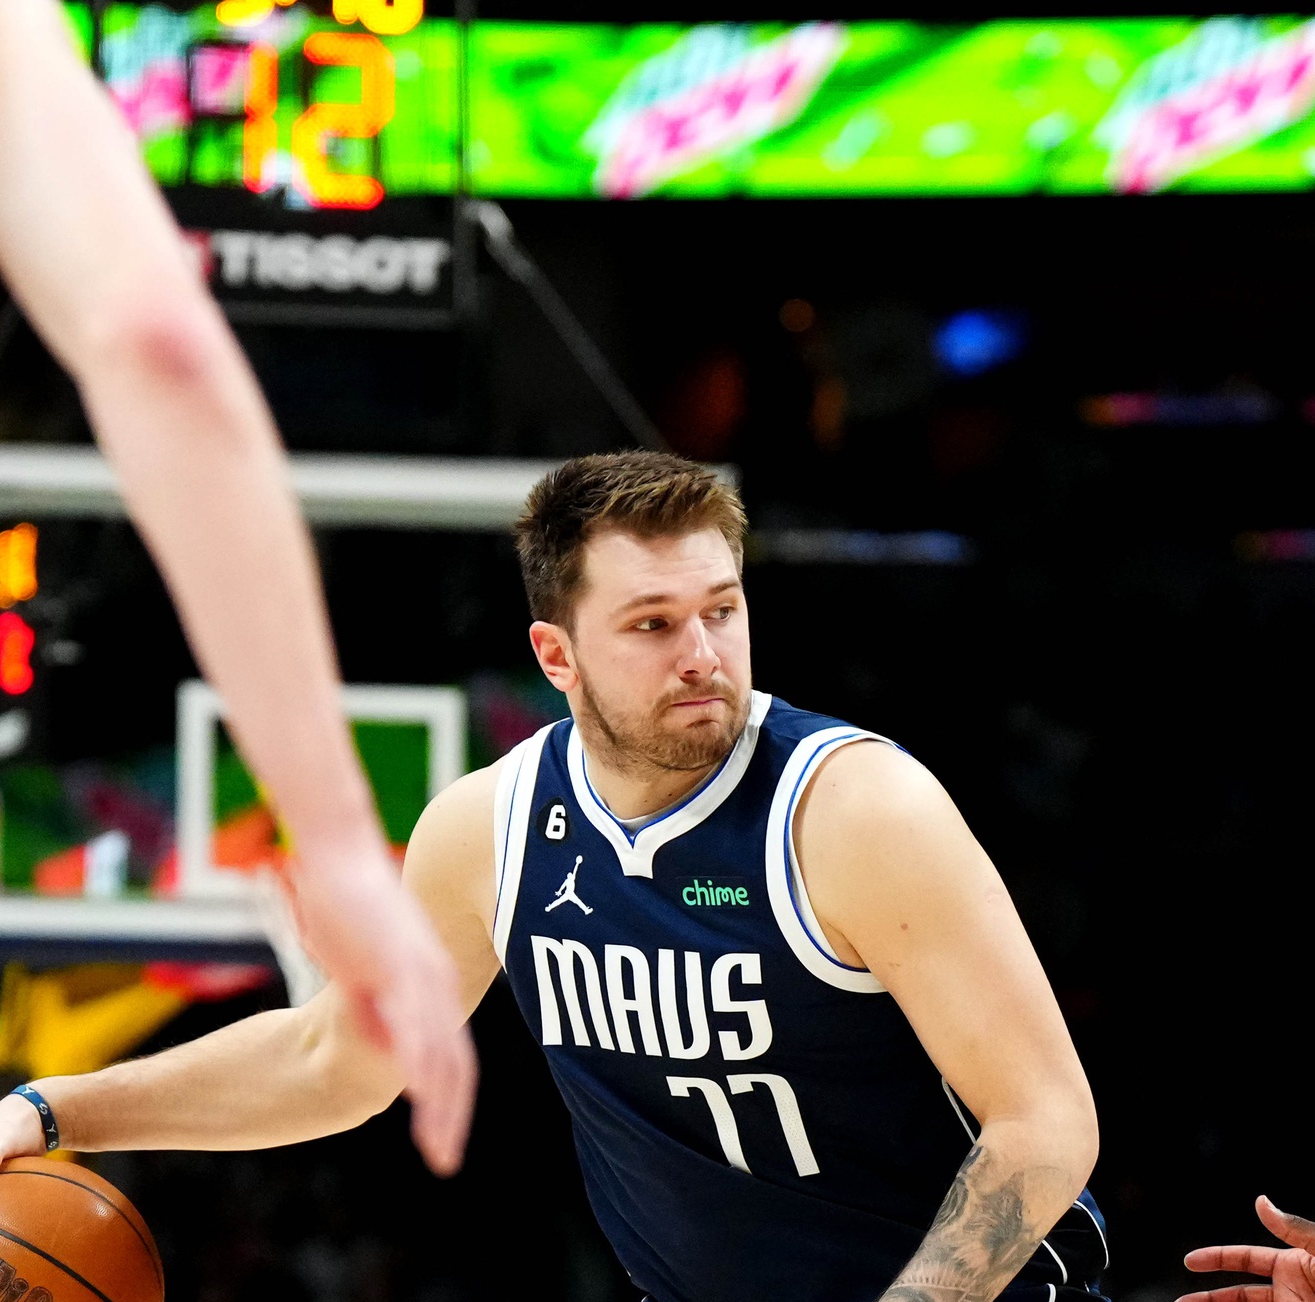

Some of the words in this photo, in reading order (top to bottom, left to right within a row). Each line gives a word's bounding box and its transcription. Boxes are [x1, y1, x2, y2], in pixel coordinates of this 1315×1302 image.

[243, 32, 396, 210] 12
[211, 231, 449, 294] TISSOT
[544, 804, 567, 840] 6
[682, 879, 750, 906] chime
[666, 1073, 820, 1178] 77
